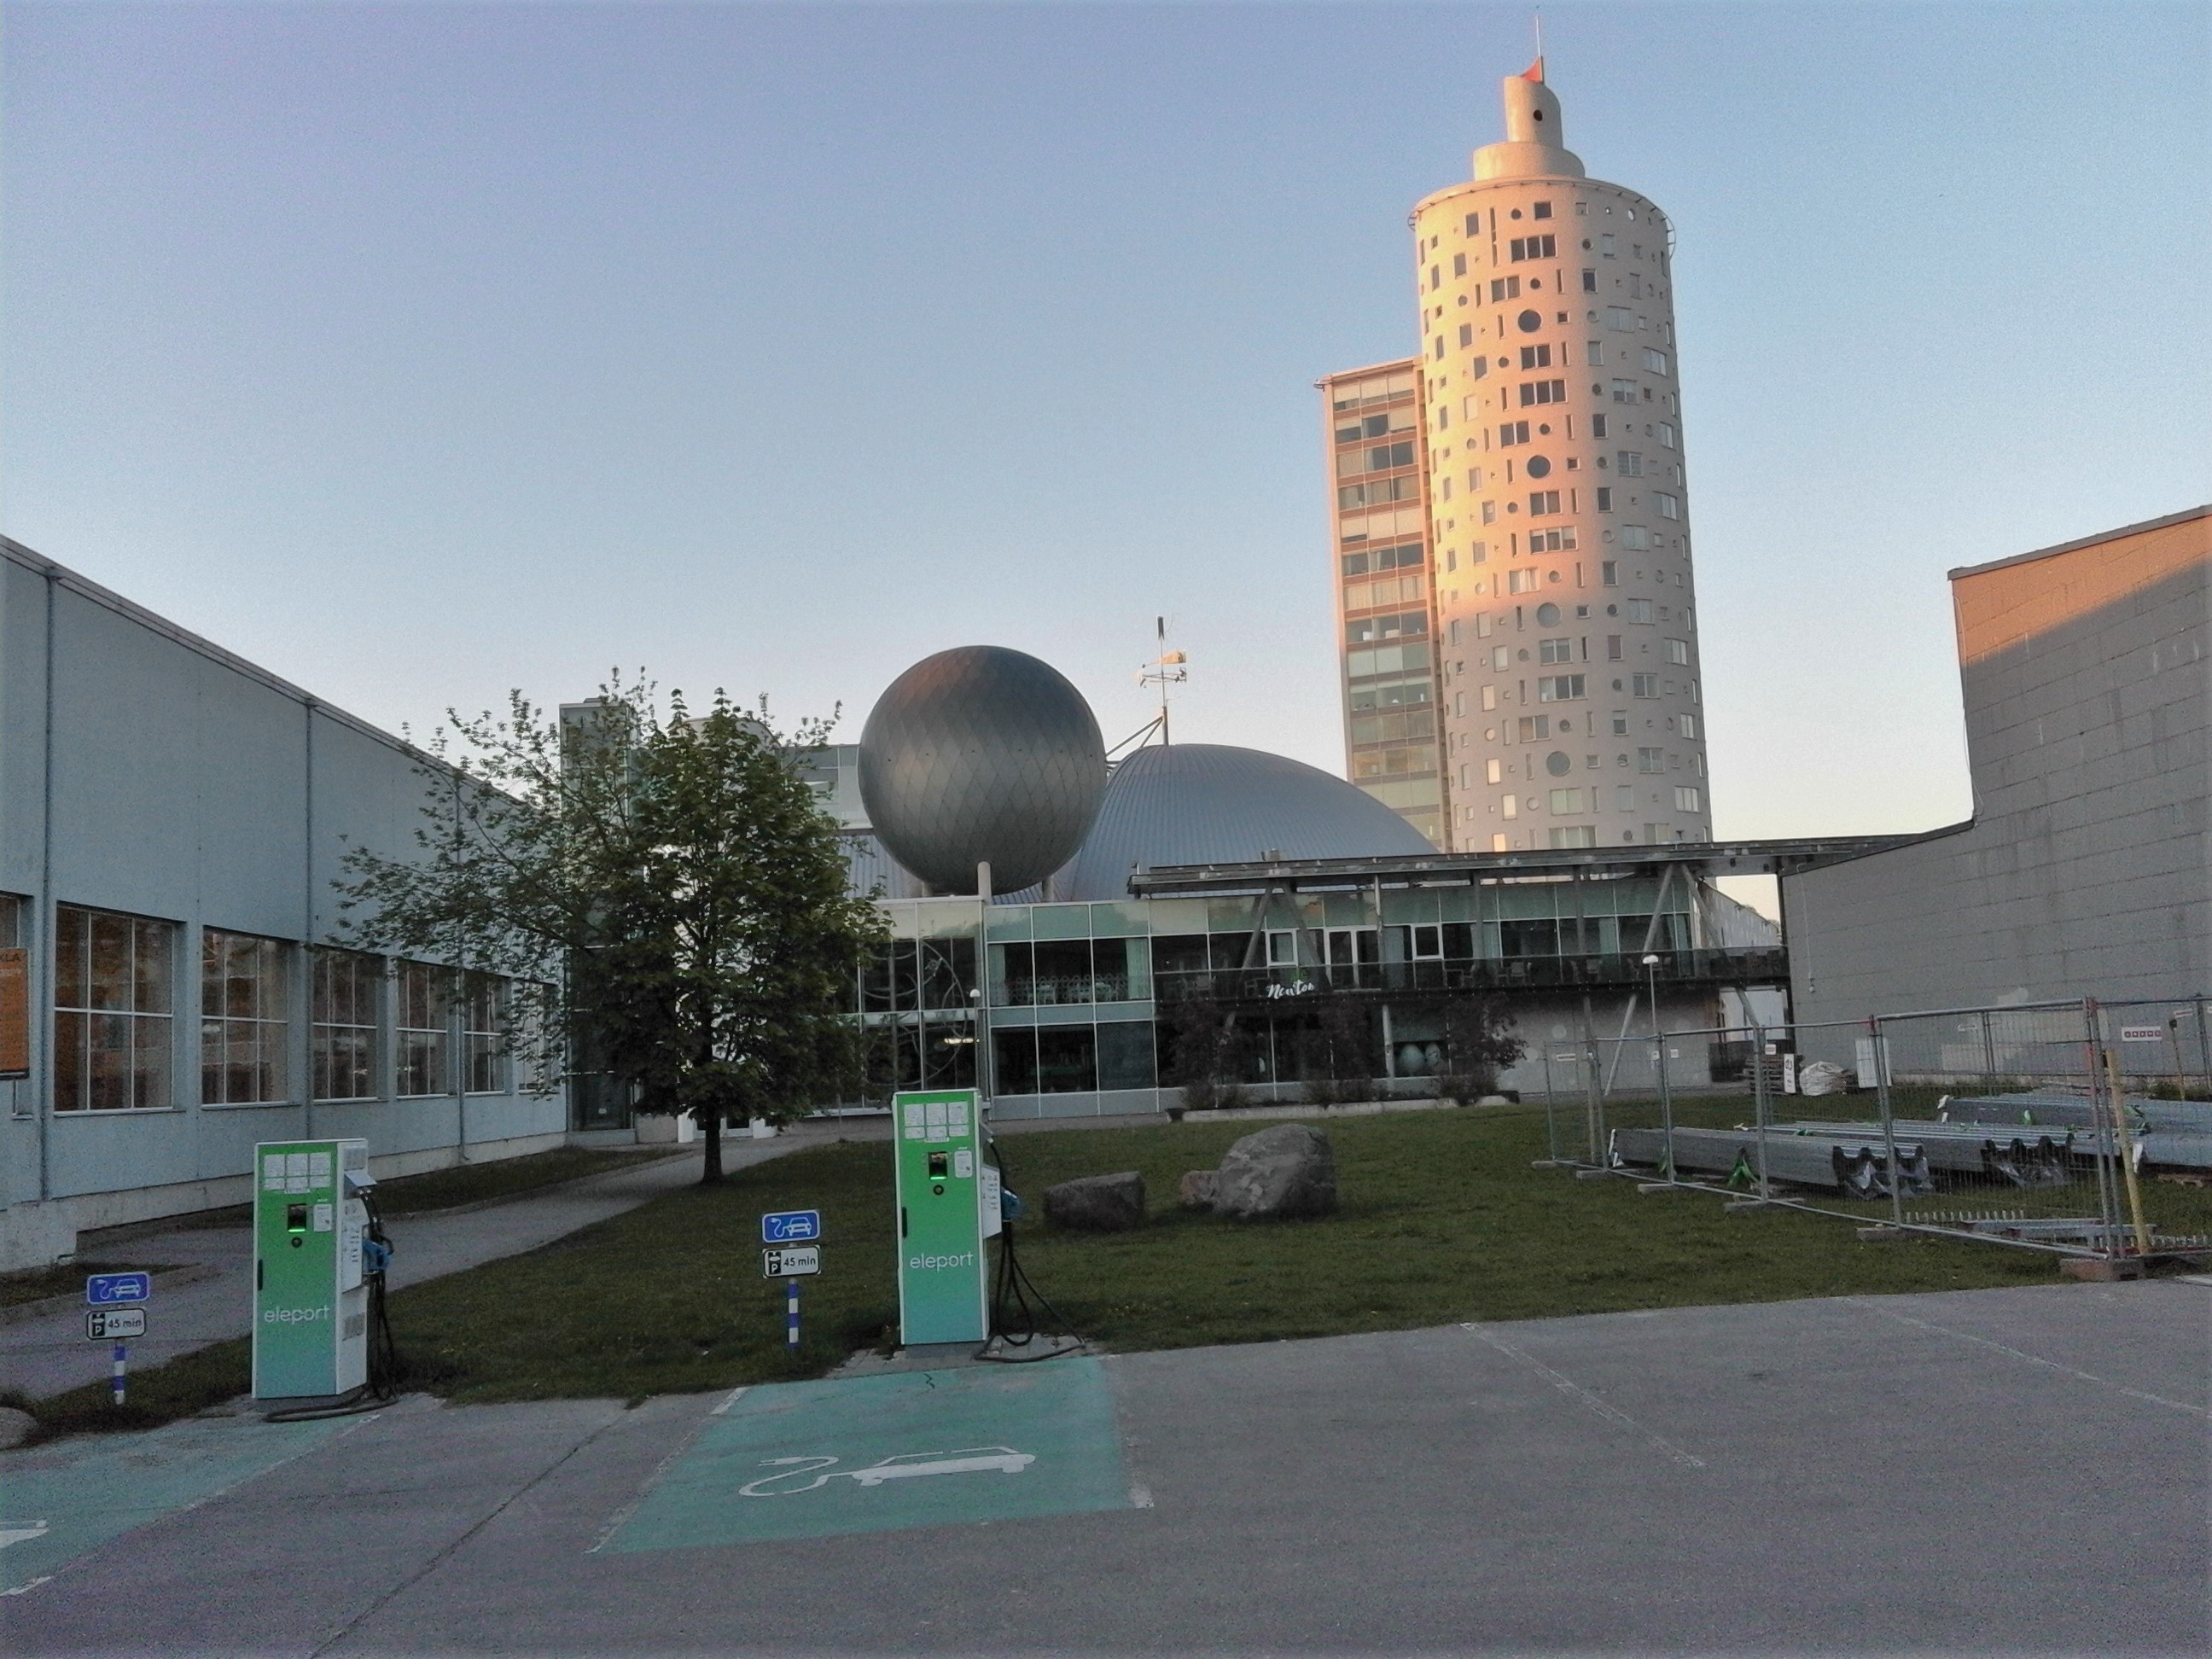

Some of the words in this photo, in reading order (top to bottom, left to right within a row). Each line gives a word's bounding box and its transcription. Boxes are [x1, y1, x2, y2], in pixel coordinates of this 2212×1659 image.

[784, 1257, 795, 1267] 45
[798, 1256, 816, 1266] min
[910, 1251, 973, 1272] eleport
[265, 1305, 329, 1324] eleport
[108, 1319, 119, 1328] 45
[123, 1318, 142, 1327] min
